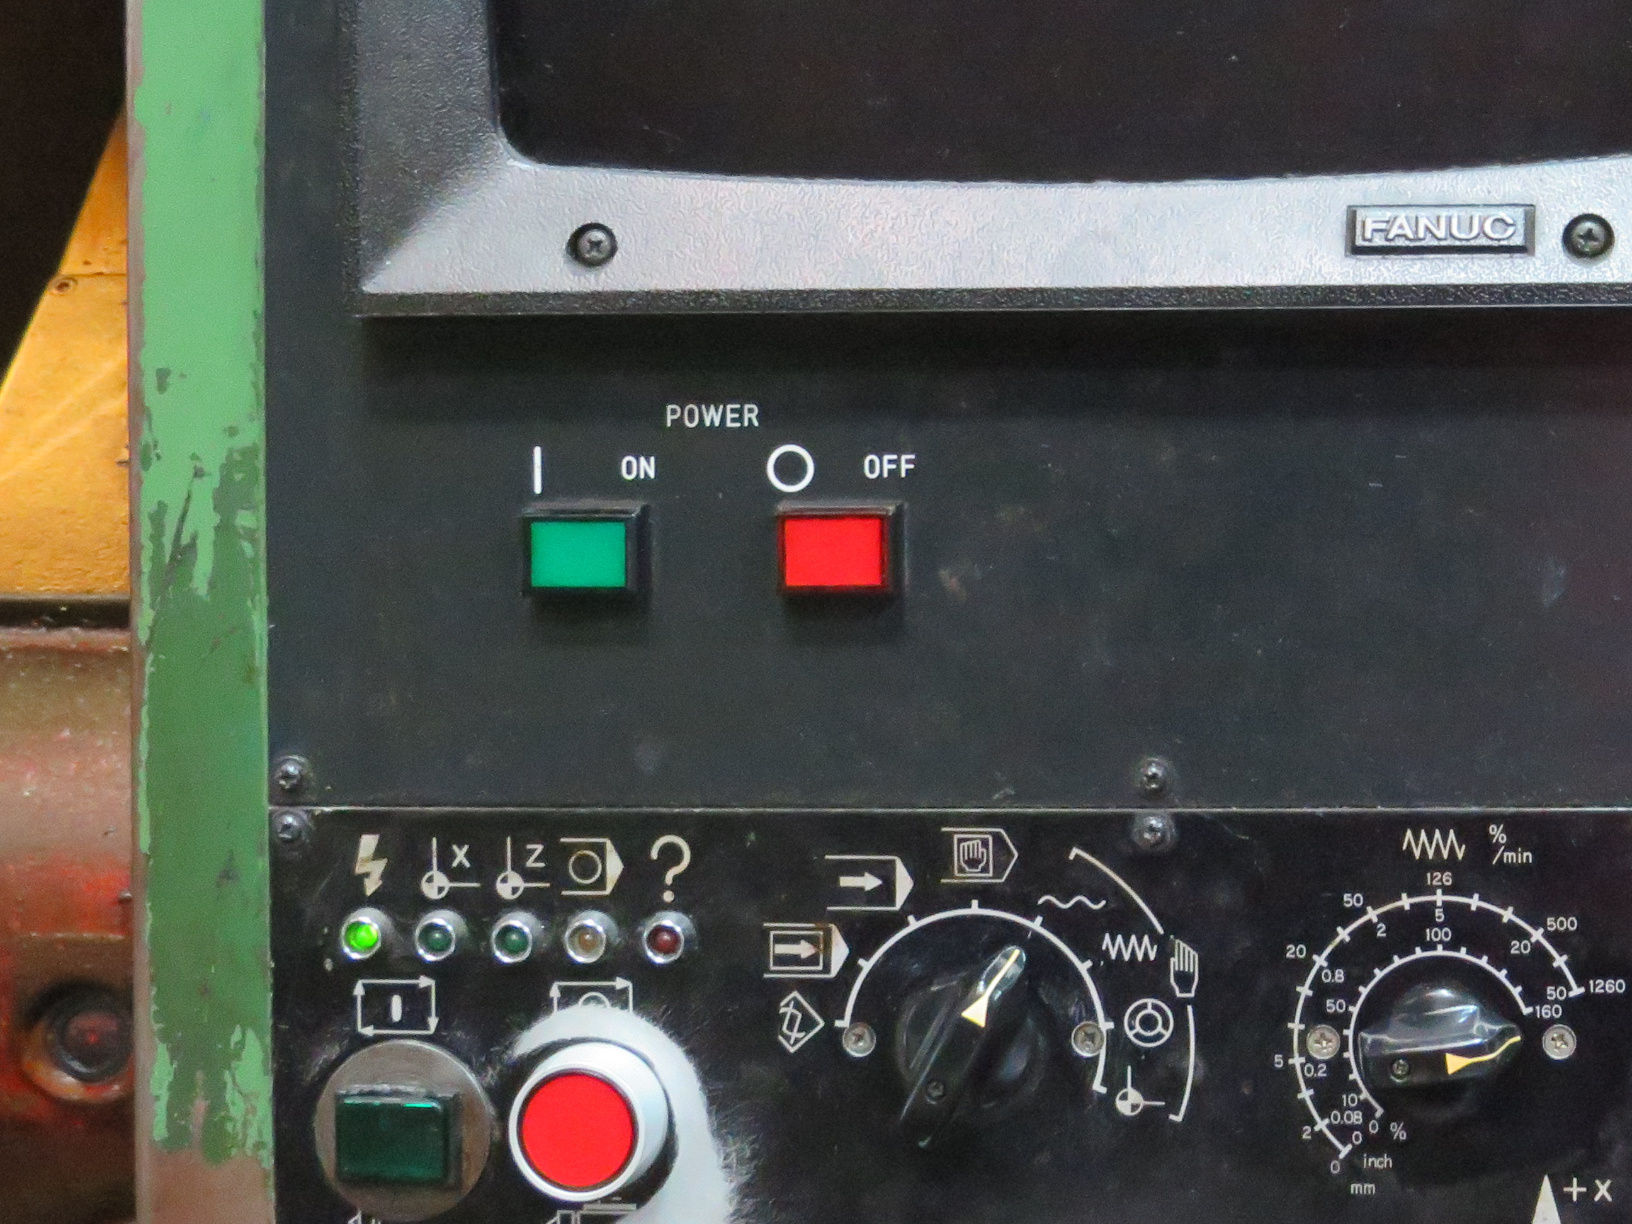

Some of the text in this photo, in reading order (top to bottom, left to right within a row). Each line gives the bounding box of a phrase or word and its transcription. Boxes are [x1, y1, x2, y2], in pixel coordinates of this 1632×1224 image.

[1361, 213, 1517, 242] FANUC
[666, 404, 759, 428] POWER
[621, 456, 656, 480] ON
[863, 454, 916, 479] OFF
[1489, 824, 1507, 845] %
[1426, 872, 1453, 886] 126
[1343, 893, 1364, 908] 50
[1435, 908, 1445, 922] 5
[1376, 923, 1387, 937] 2
[1546, 917, 1578, 931] 500
[1425, 928, 1452, 942] 100
[1286, 944, 1307, 959] 20
[1510, 940, 1531, 955] 20
[1321, 969, 1345, 983] 0.8
[1546, 986, 1567, 1000] 50
[1588, 979, 1626, 994] 1260
[1326, 999, 1346, 1014] 50
[1535, 1004, 1562, 1019] 160
[1274, 1054, 1284, 1069] 5
[1304, 1063, 1327, 1077] 0.2
[1342, 1093, 1358, 1107] 10
[1331, 1110, 1363, 1125] 0.08
[1302, 1126, 1312, 1140] 2
[1369, 1120, 1379, 1134] 0
[1352, 1131, 1362, 1145] 0
[1330, 1160, 1340, 1174] 0
[1363, 1153, 1393, 1169] inch
[1350, 1182, 1376, 1195] mm
